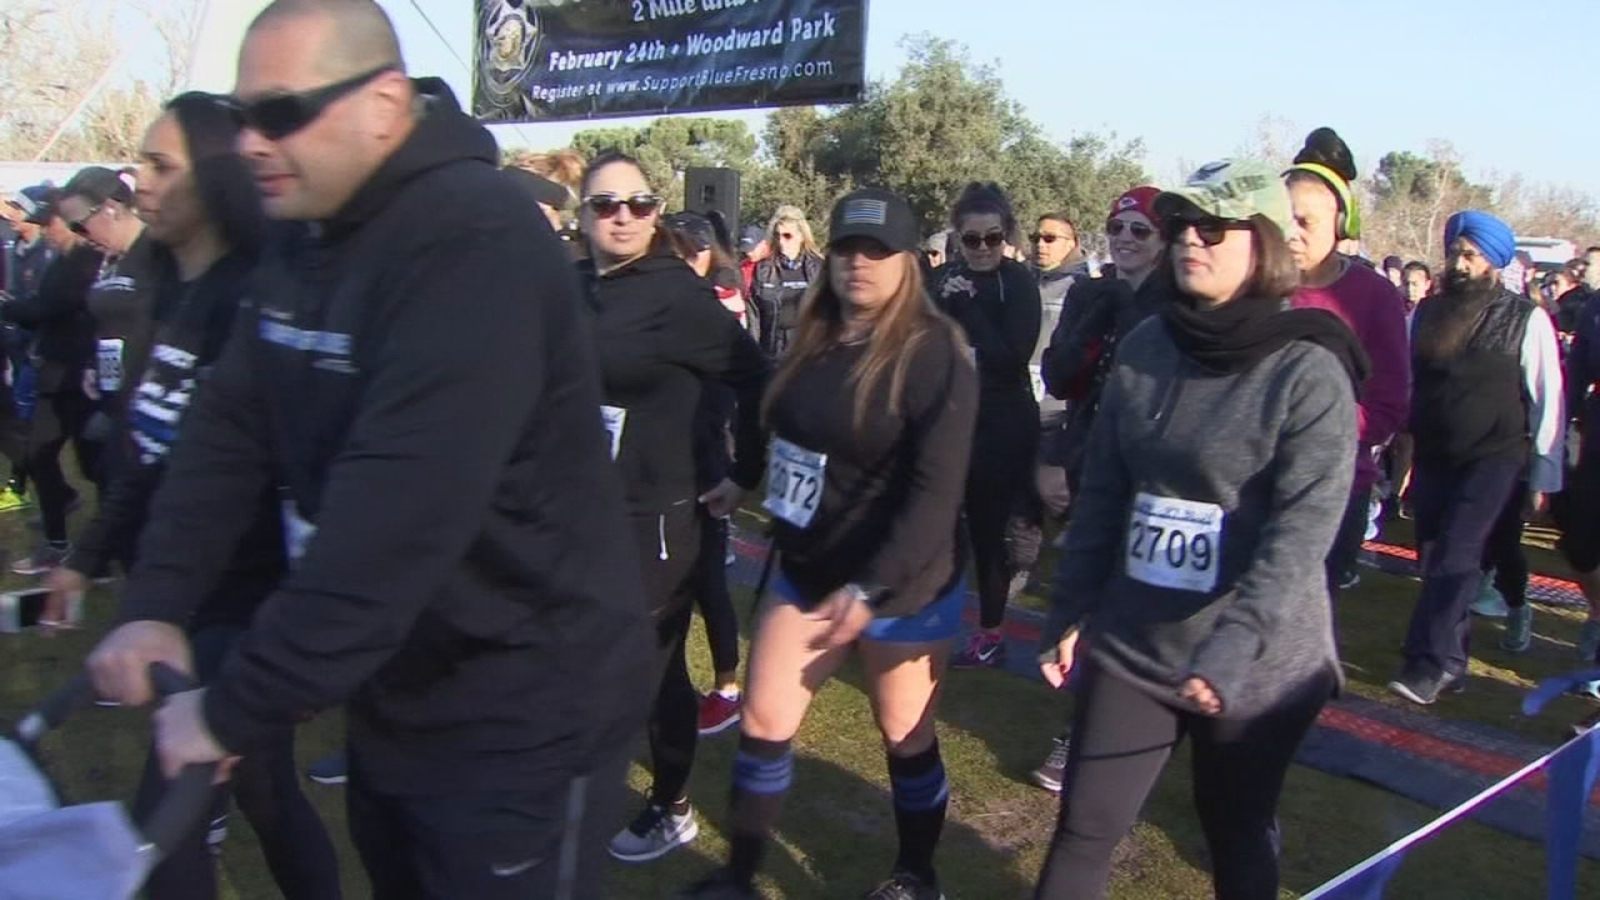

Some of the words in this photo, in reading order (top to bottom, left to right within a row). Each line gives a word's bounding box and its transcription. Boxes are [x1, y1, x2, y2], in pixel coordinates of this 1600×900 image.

[632, 0, 645, 22] 2
[649, 0, 697, 19] Mile
[549, 50, 622, 71] February
[625, 40, 666, 63] 24th
[686, 21, 784, 56] Woodward
[790, 12, 836, 42] Park
[532, 84, 585, 103] Register
[586, 82, 602, 96] at
[606, 60, 833, 94] www.SupportBlueFresno.com
[1132, 520, 1211, 571] 2709
